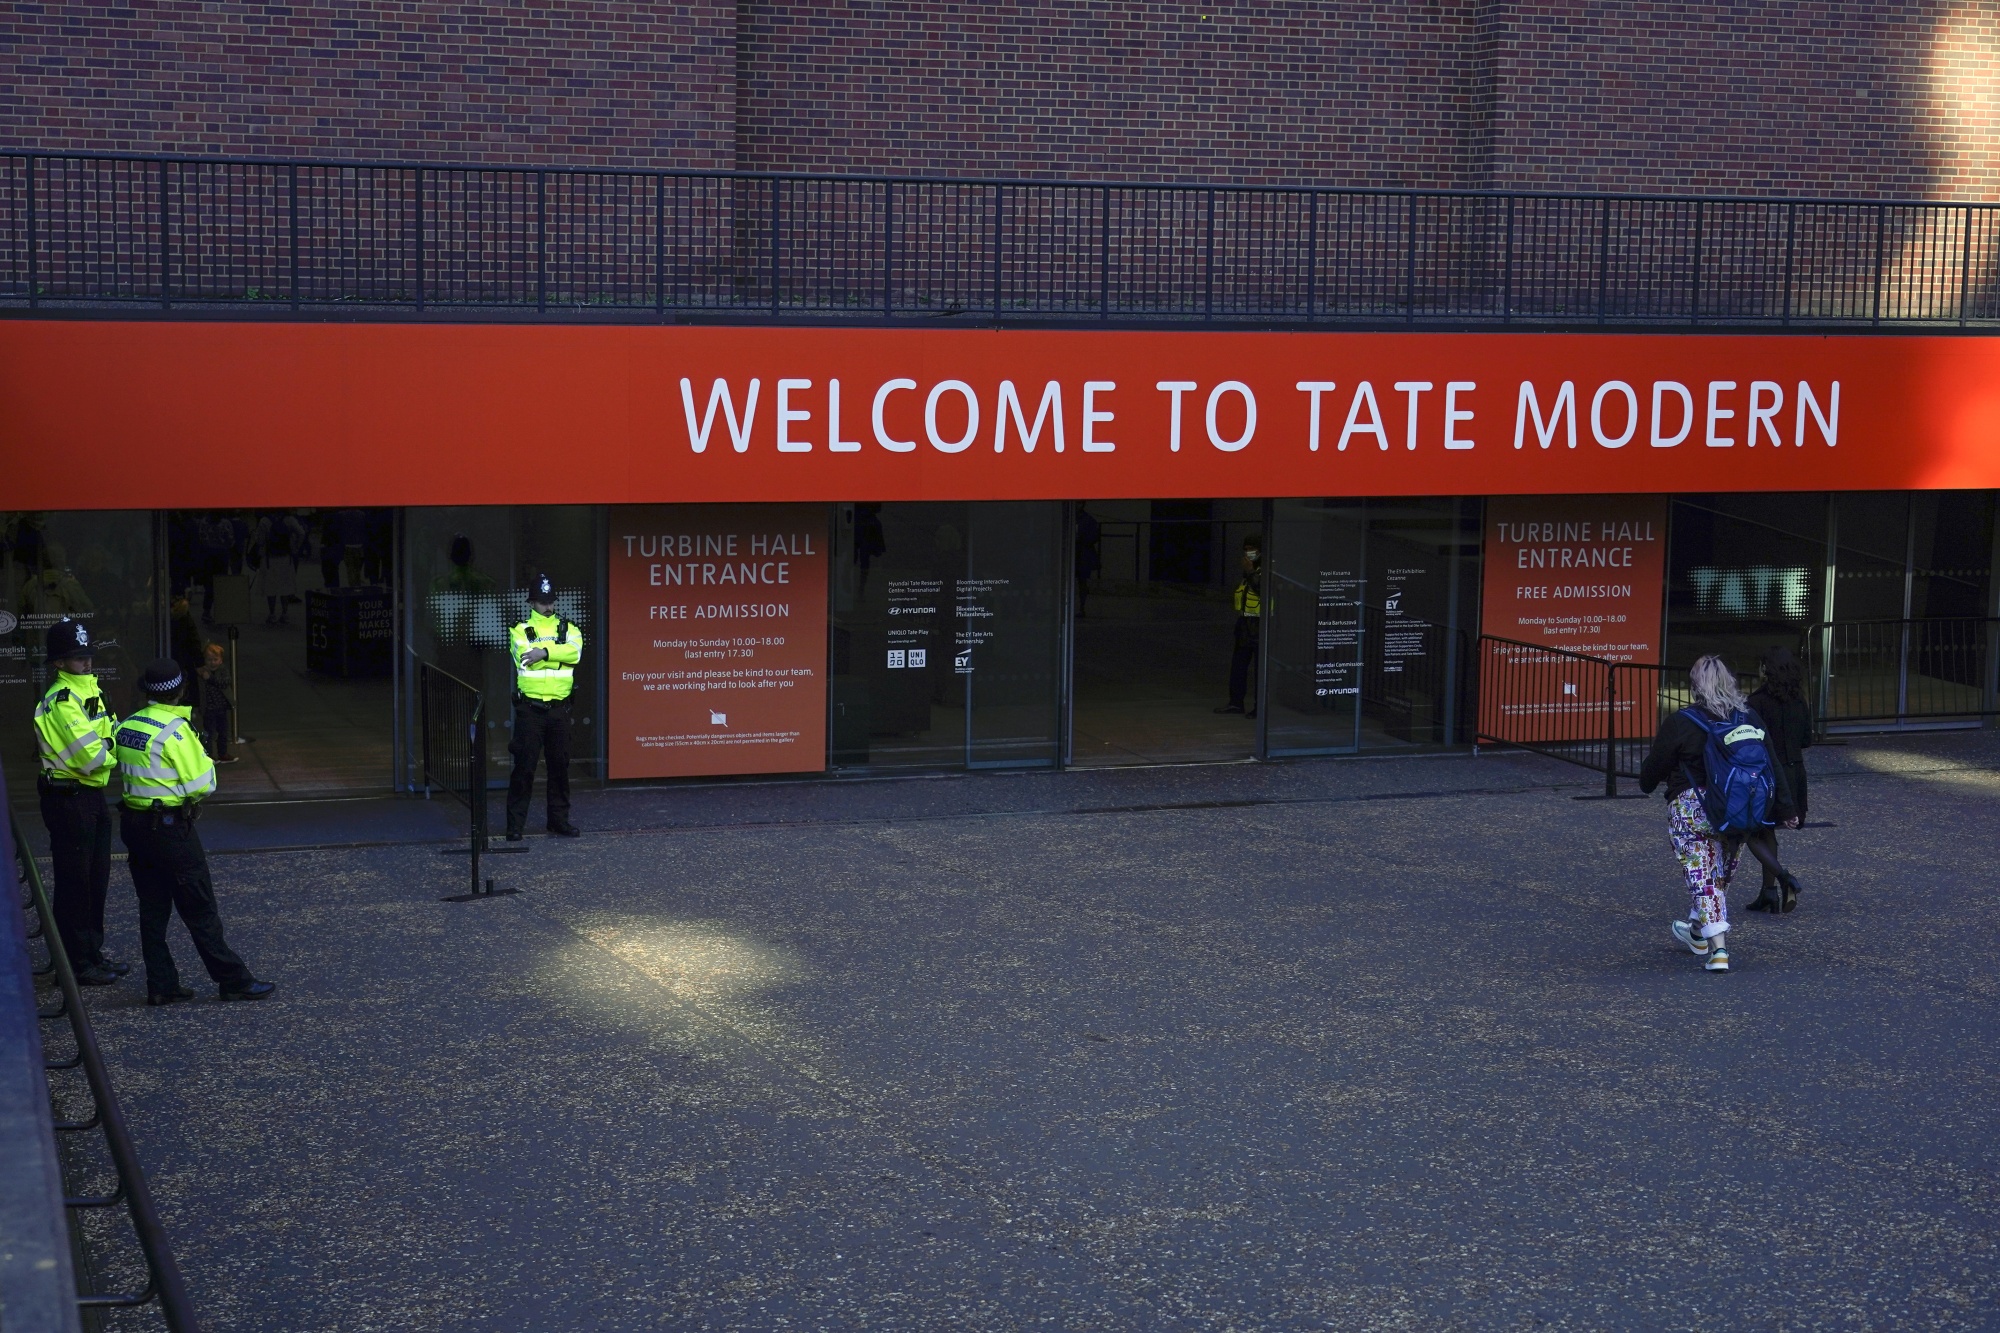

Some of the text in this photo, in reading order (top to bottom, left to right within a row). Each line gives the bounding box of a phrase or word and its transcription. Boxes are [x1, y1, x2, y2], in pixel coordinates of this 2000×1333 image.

[680, 377, 1840, 453] WELCOME TO TATE MODERN
[1498, 522, 1654, 542] TURBINE HALL
[623, 534, 816, 557] TURBINE HALL
[1518, 548, 1632, 568] ENTRANCE
[650, 562, 790, 586] ENTRANCE
[1516, 585, 1630, 599] FREE ADMISSION
[358, 600, 383, 609] YOUR
[1386, 600, 1398, 610] EY
[650, 604, 789, 619] FREE ADMISSION
[359, 619, 390, 629] MAKES
[1518, 617, 1546, 626] Monday
[1556, 616, 1582, 625] Sunday
[312, 623, 328, 648] £5
[1559, 626, 1578, 635] entry
[654, 639, 688, 649] Monday
[700, 638, 730, 648] Sunday
[685, 649, 753, 659] (last entry 17.30)
[955, 656, 970, 668] EY
[623, 672, 645, 681] Enjoy
[647, 673, 666, 681] your
[686, 670, 702, 678] and
[704, 670, 731, 679] please
[733, 669, 744, 677] be
[745, 668, 763, 677] kind
[672, 682, 706, 691] working
[708, 680, 726, 689] hard
[738, 680, 756, 688] look
[758, 679, 777, 688] after
[779, 681, 794, 689] you
[118, 734, 146, 749] POLICE
